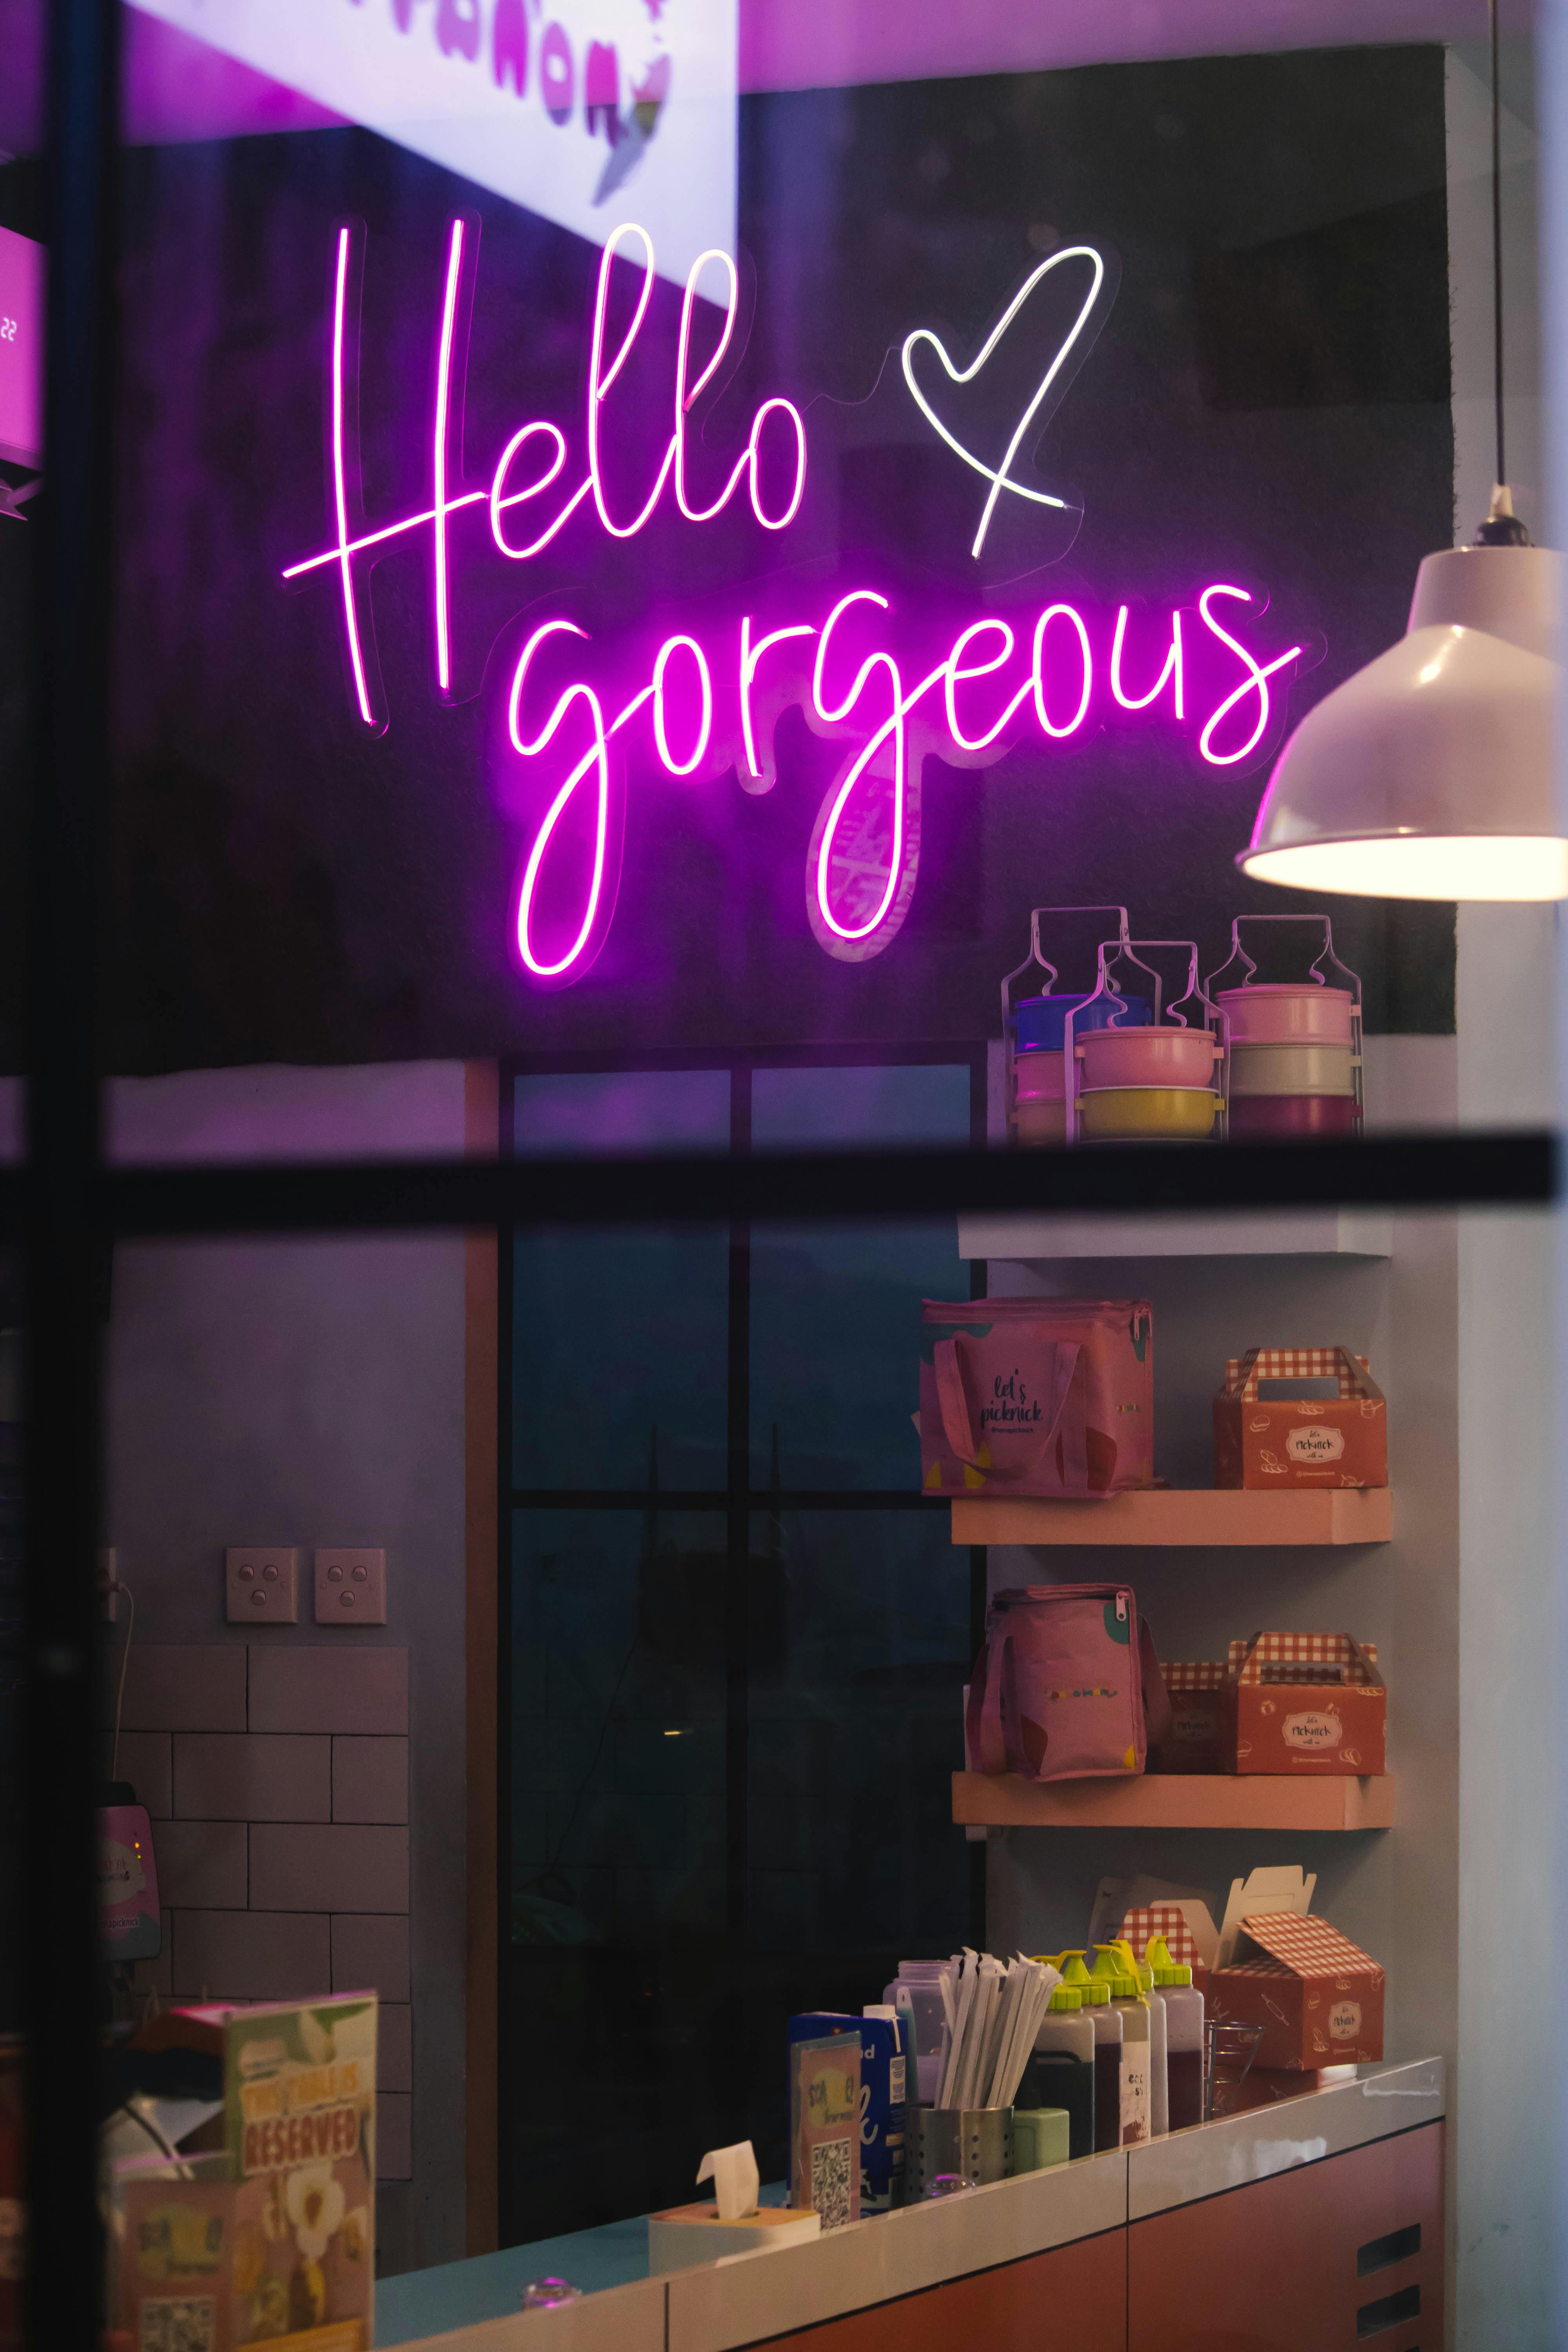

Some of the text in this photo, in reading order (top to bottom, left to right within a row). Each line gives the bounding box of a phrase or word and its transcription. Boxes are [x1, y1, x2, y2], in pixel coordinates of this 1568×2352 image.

[282, 218, 808, 726] Hello
[507, 584, 1303, 976] gorgeous
[981, 1400, 1043, 1428] picknick
[995, 1368, 1026, 1400] let's
[244, 2108, 357, 2169] RESERVED
